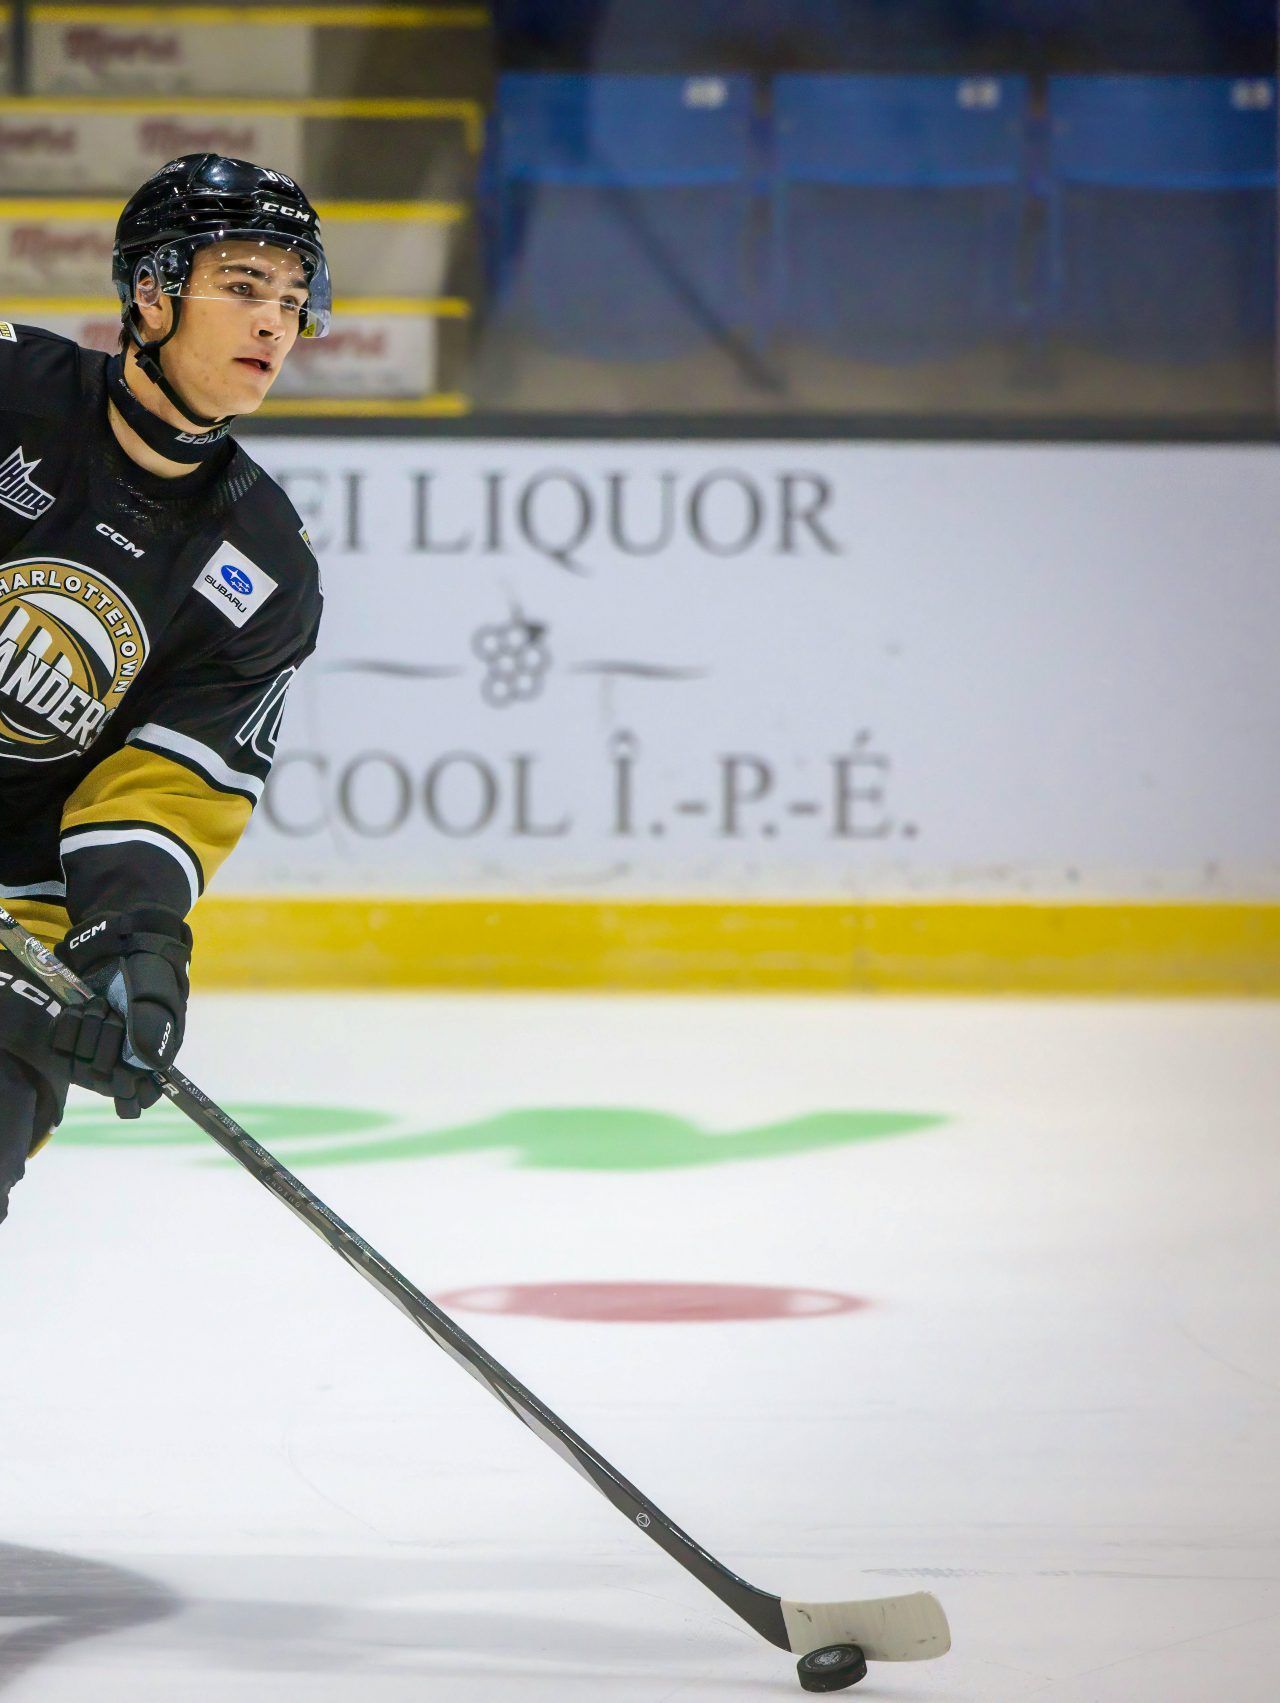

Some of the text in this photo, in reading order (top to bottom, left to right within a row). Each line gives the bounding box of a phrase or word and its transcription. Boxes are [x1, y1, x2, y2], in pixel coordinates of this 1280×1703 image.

[261, 201, 311, 223] CCM
[409, 466, 845, 576] LIQUOR
[95, 522, 146, 559] CCM
[203, 574, 248, 613] SUBARU
[603, 727, 920, 842] Î.-P.-É.
[70, 920, 107, 950] CCM
